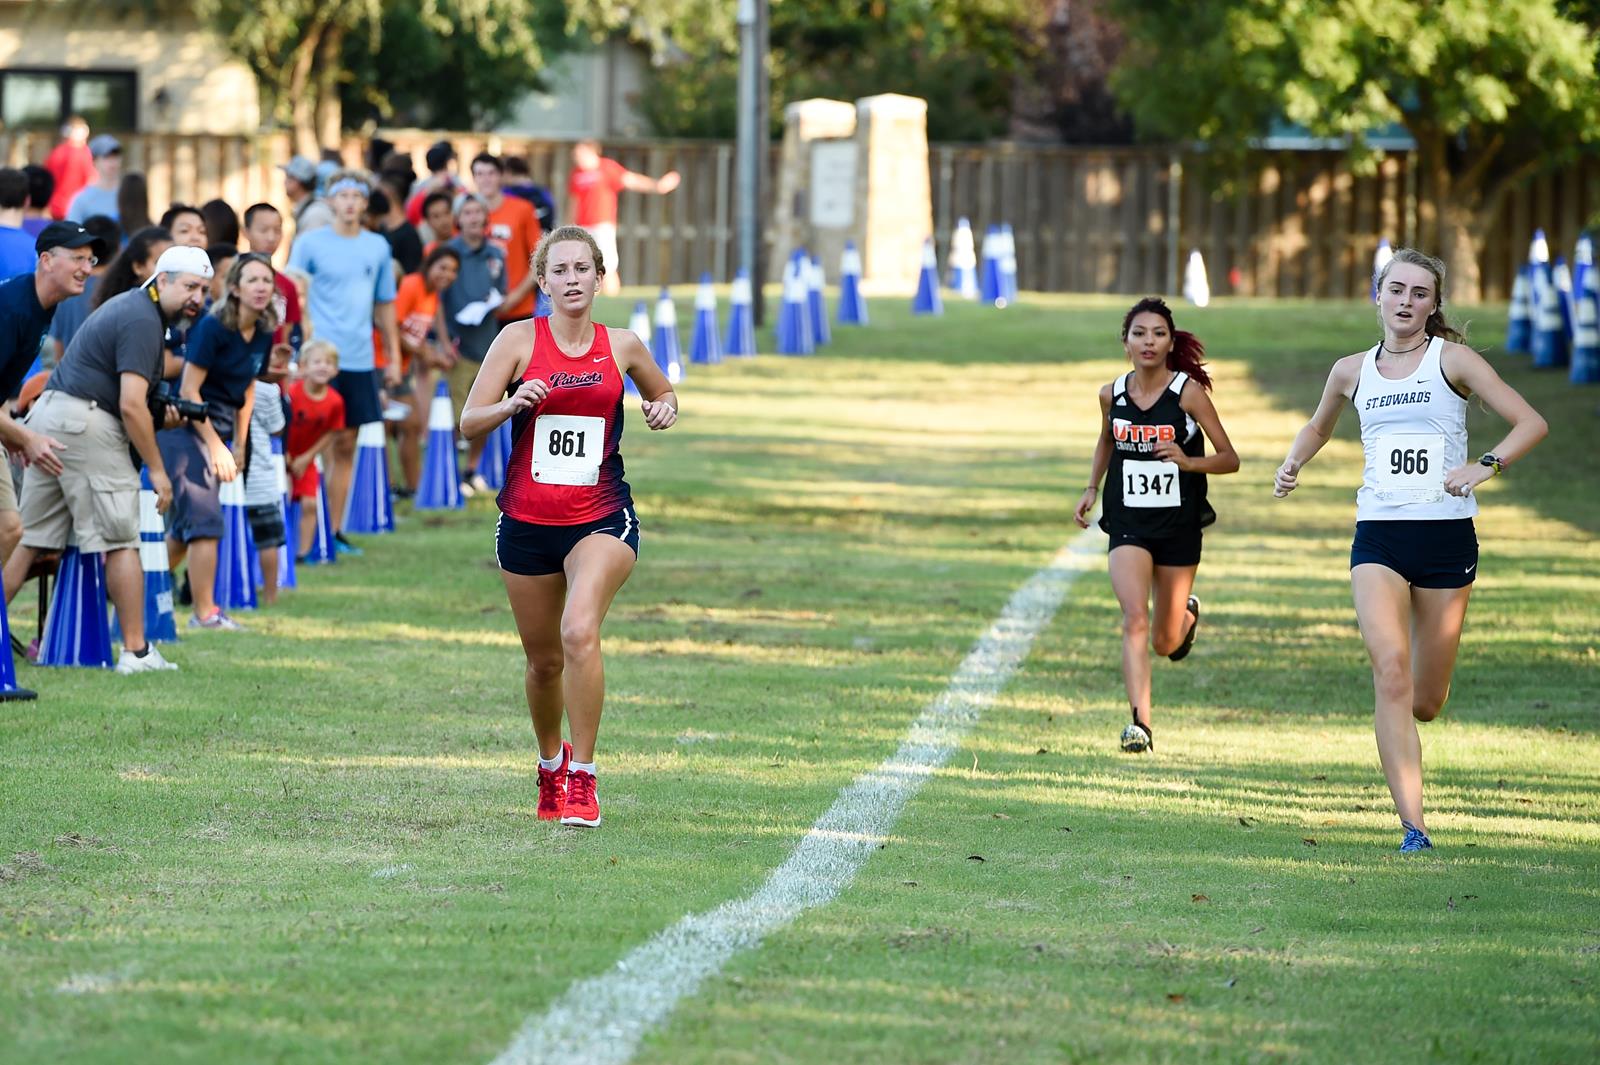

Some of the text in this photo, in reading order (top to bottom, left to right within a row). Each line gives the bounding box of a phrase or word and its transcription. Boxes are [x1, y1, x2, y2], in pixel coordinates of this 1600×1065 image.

[549, 371, 604, 389] Patriots
[1113, 421, 1176, 442] UTPB
[548, 429, 586, 457] 861
[1390, 448, 1429, 475] 966
[1127, 473, 1174, 495] 1347
